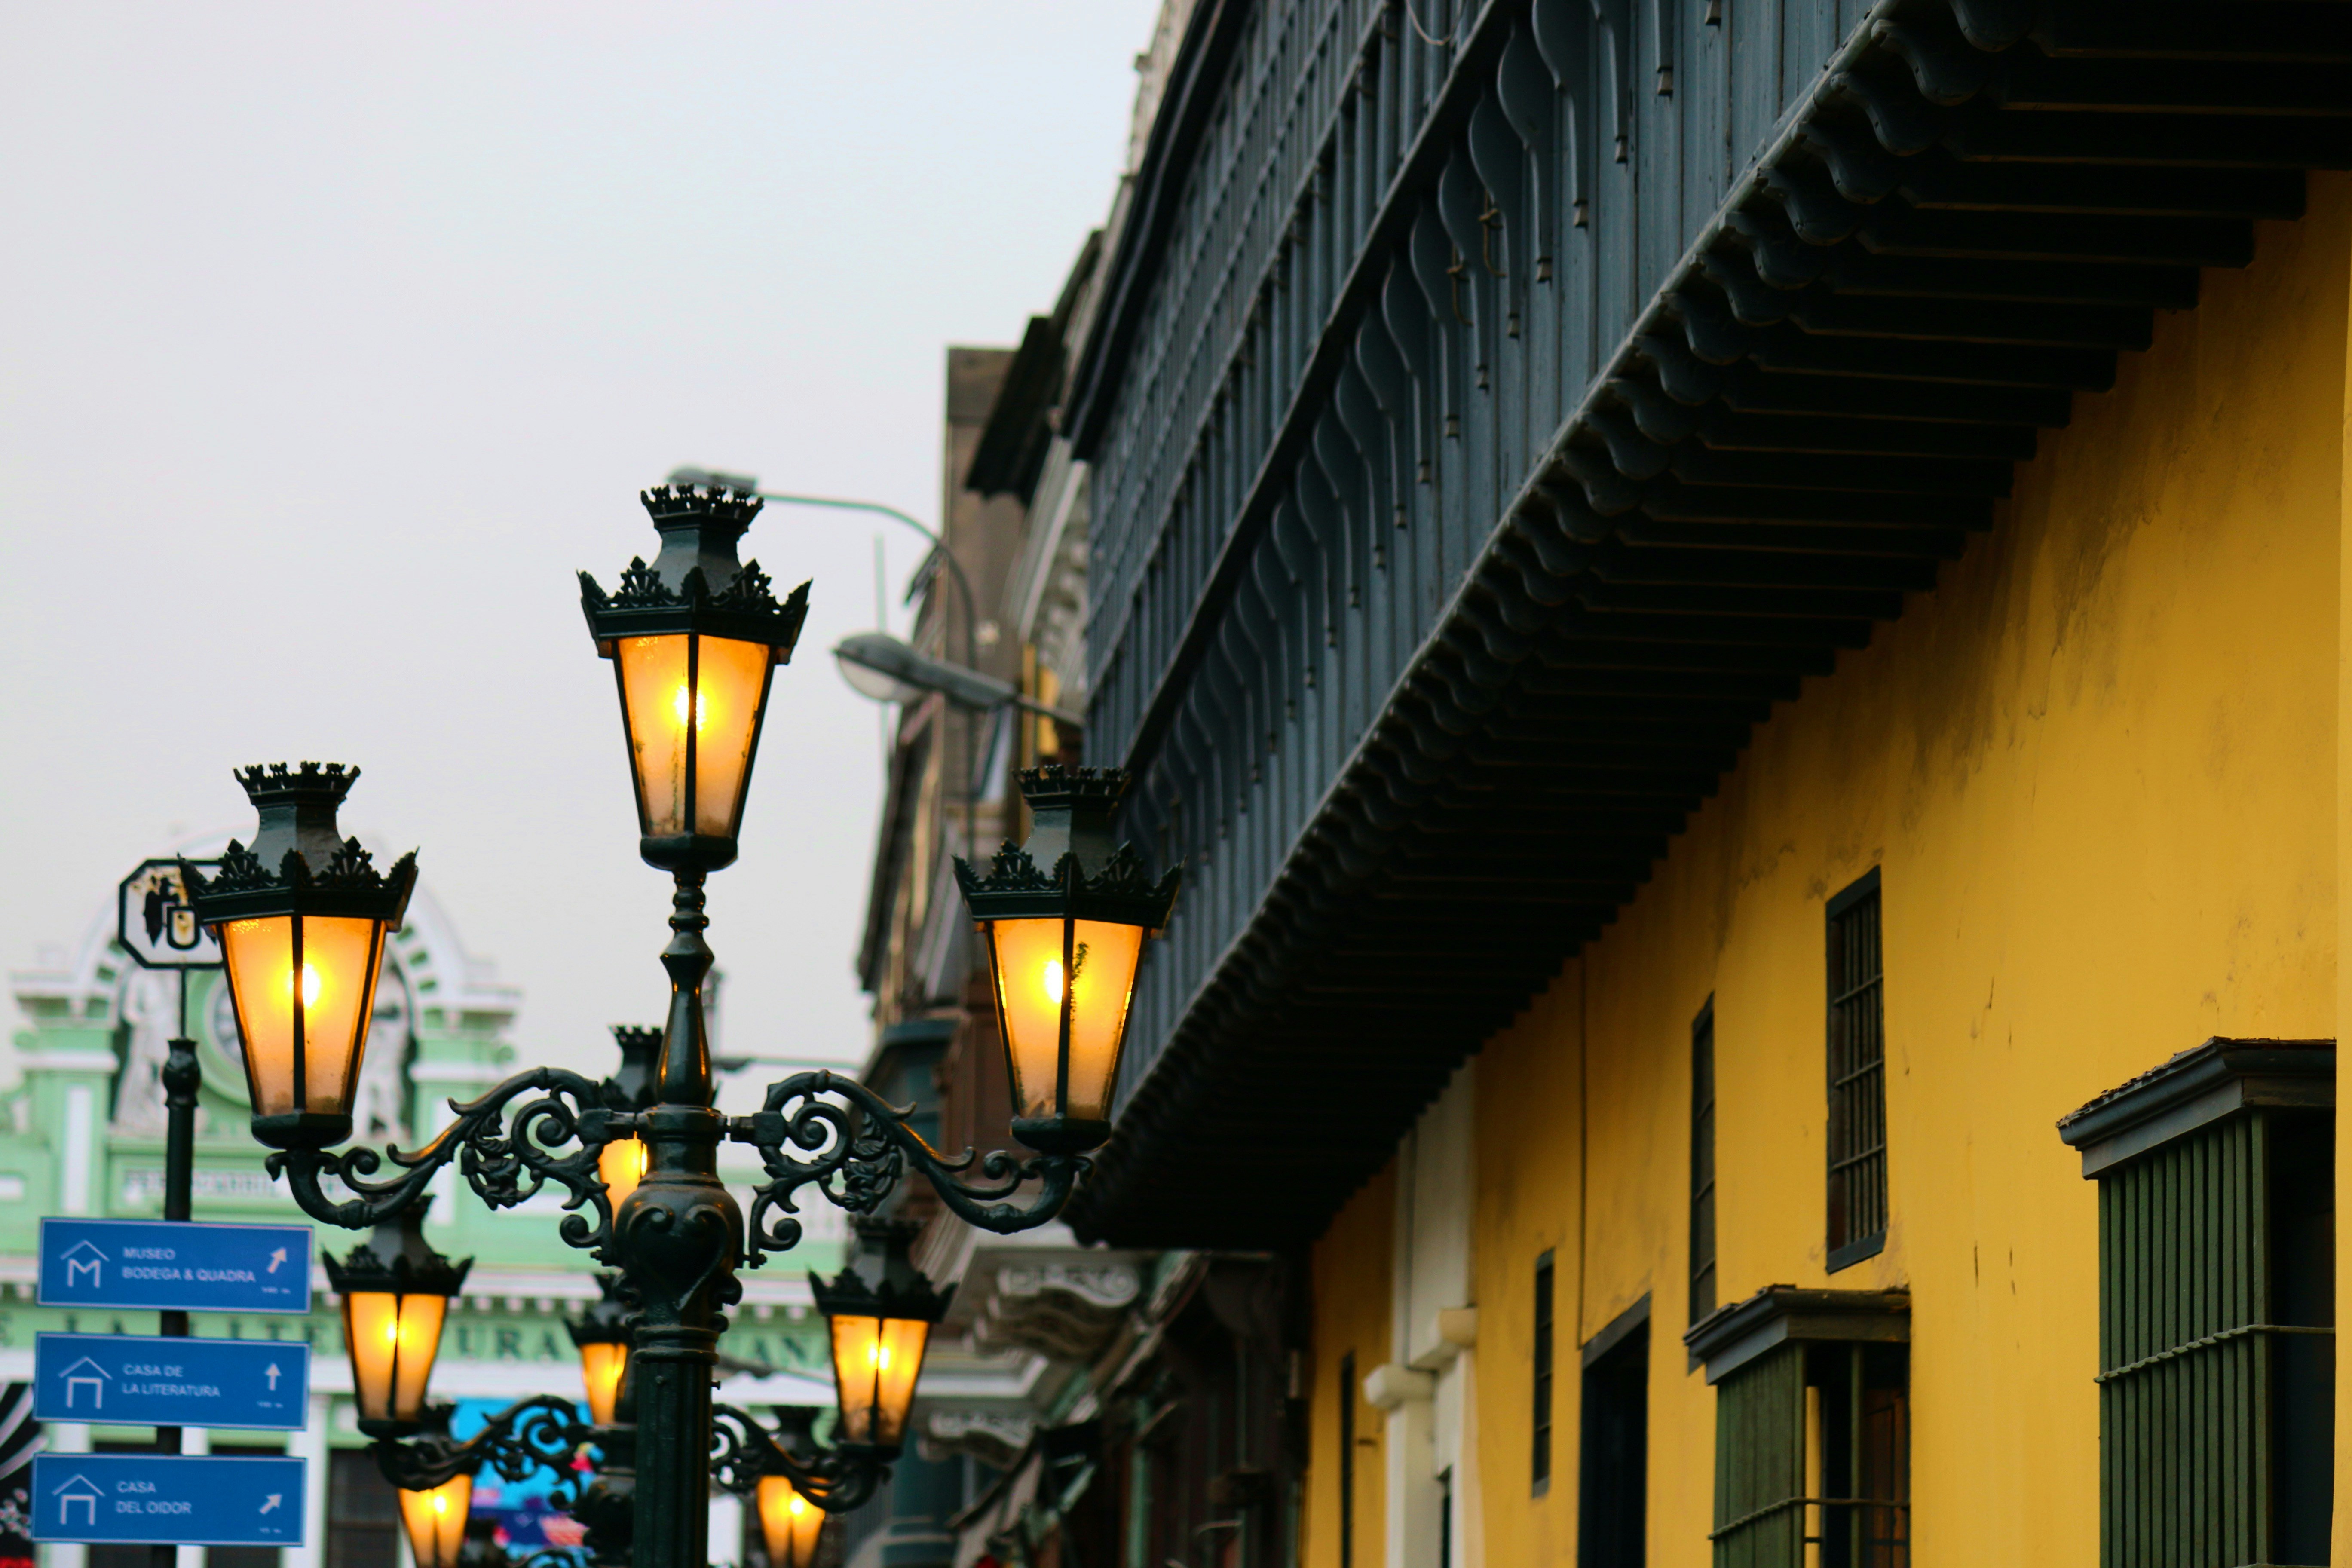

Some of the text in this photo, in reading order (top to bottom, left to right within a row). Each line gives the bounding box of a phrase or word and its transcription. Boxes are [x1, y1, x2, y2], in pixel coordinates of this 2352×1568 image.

[123, 1247, 176, 1260] MUSEO
[122, 1266, 256, 1283] BODEGA & QUADRA
[123, 1363, 184, 1377] CASA DE
[122, 1383, 221, 1397] LA LITERATURA
[116, 1481, 156, 1493] CASA
[116, 1500, 192, 1515] DEL OIDOR
